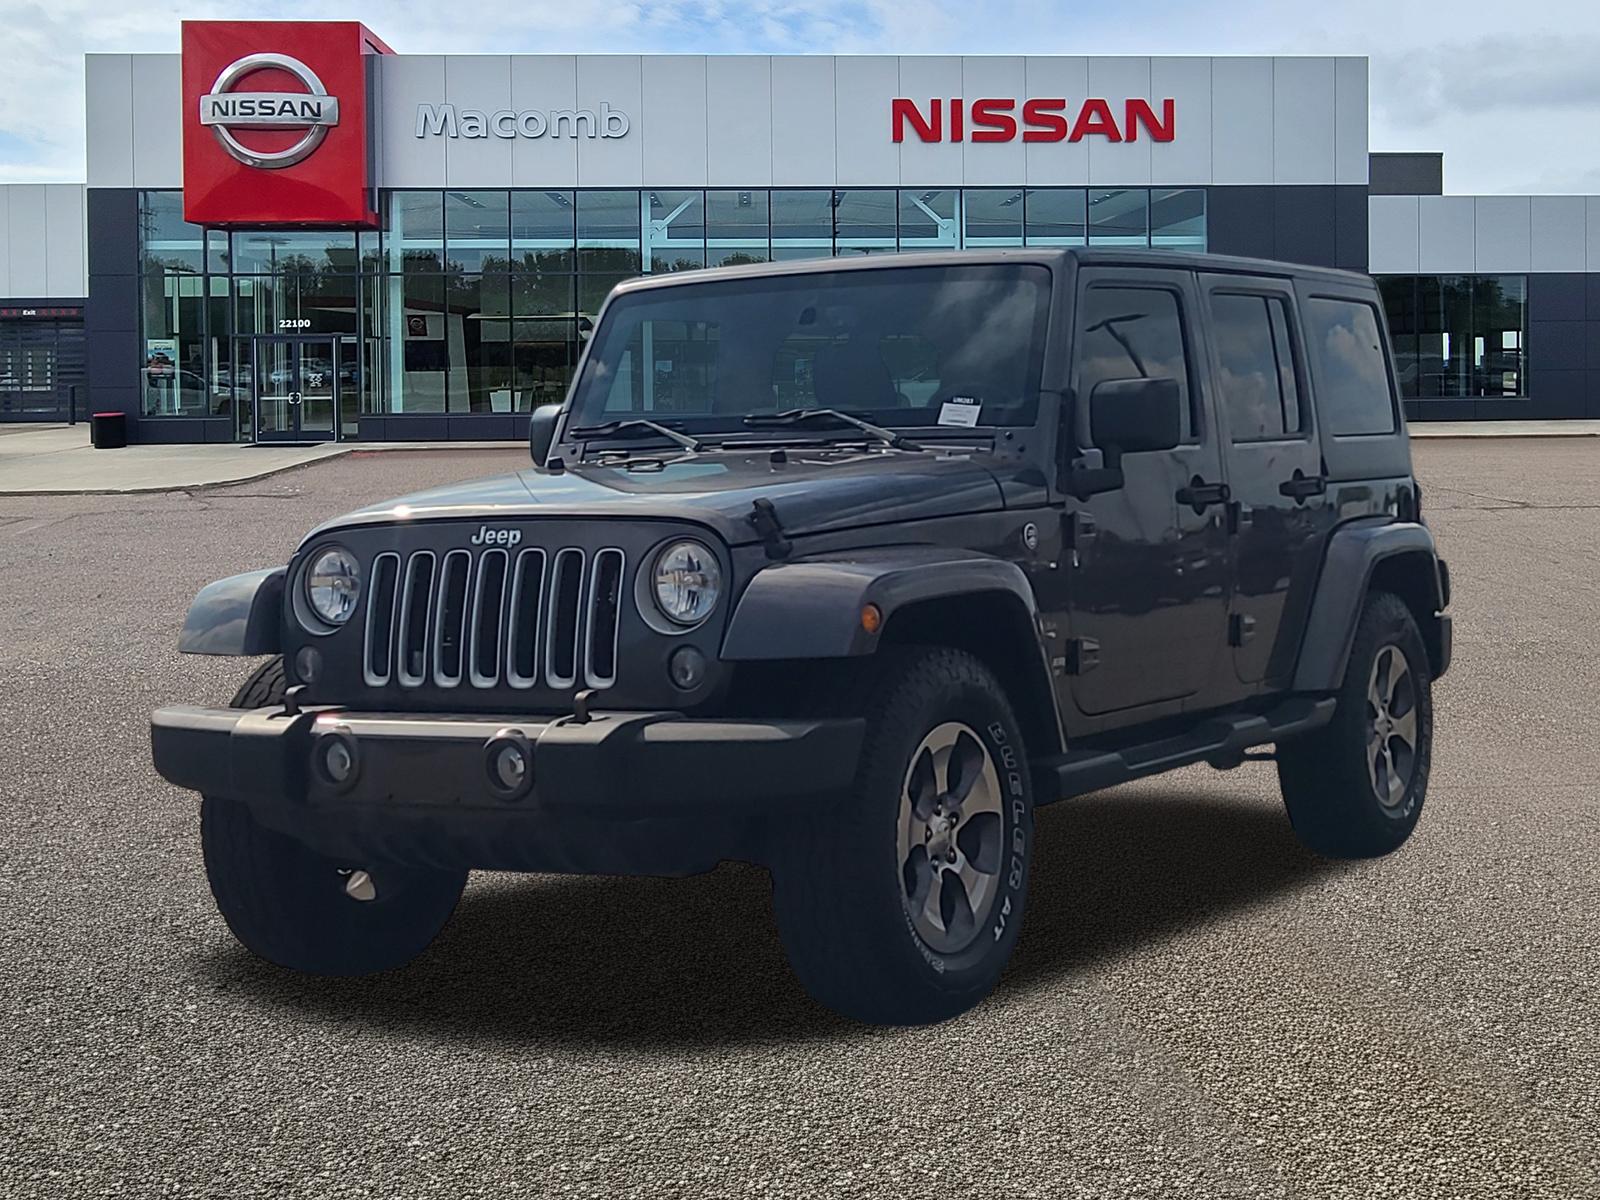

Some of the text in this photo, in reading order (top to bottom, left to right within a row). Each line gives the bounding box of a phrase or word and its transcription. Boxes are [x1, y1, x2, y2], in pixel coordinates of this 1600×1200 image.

[211, 99, 323, 118] NISSAN
[415, 102, 630, 139] Macomb
[892, 98, 1176, 143] NISSAN
[279, 319, 311, 328] 22100
[471, 525, 521, 548] Jeep
